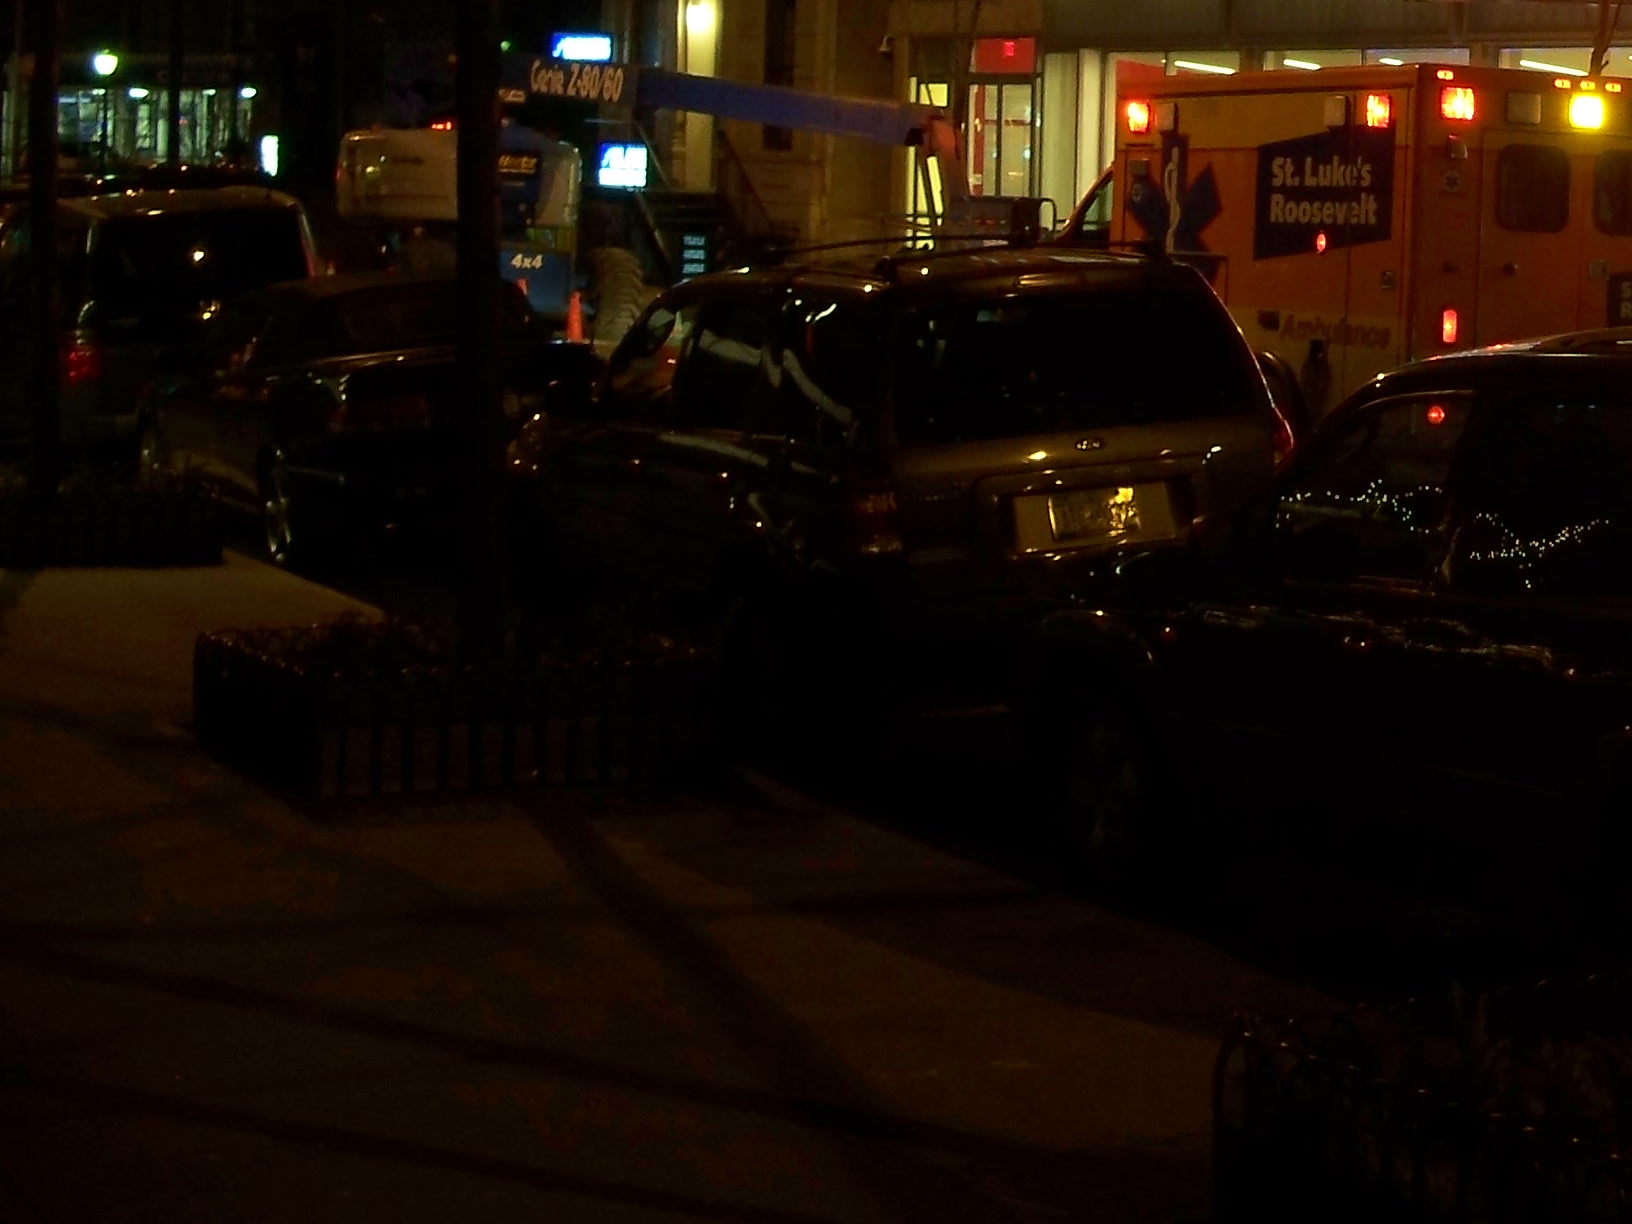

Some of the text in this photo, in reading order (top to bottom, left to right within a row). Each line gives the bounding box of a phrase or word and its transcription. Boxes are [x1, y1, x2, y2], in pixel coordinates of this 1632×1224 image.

[1272, 155, 1372, 187] St. Luke's
[1270, 192, 1378, 225] Roosevelt
[510, 253, 544, 270] 4x4
